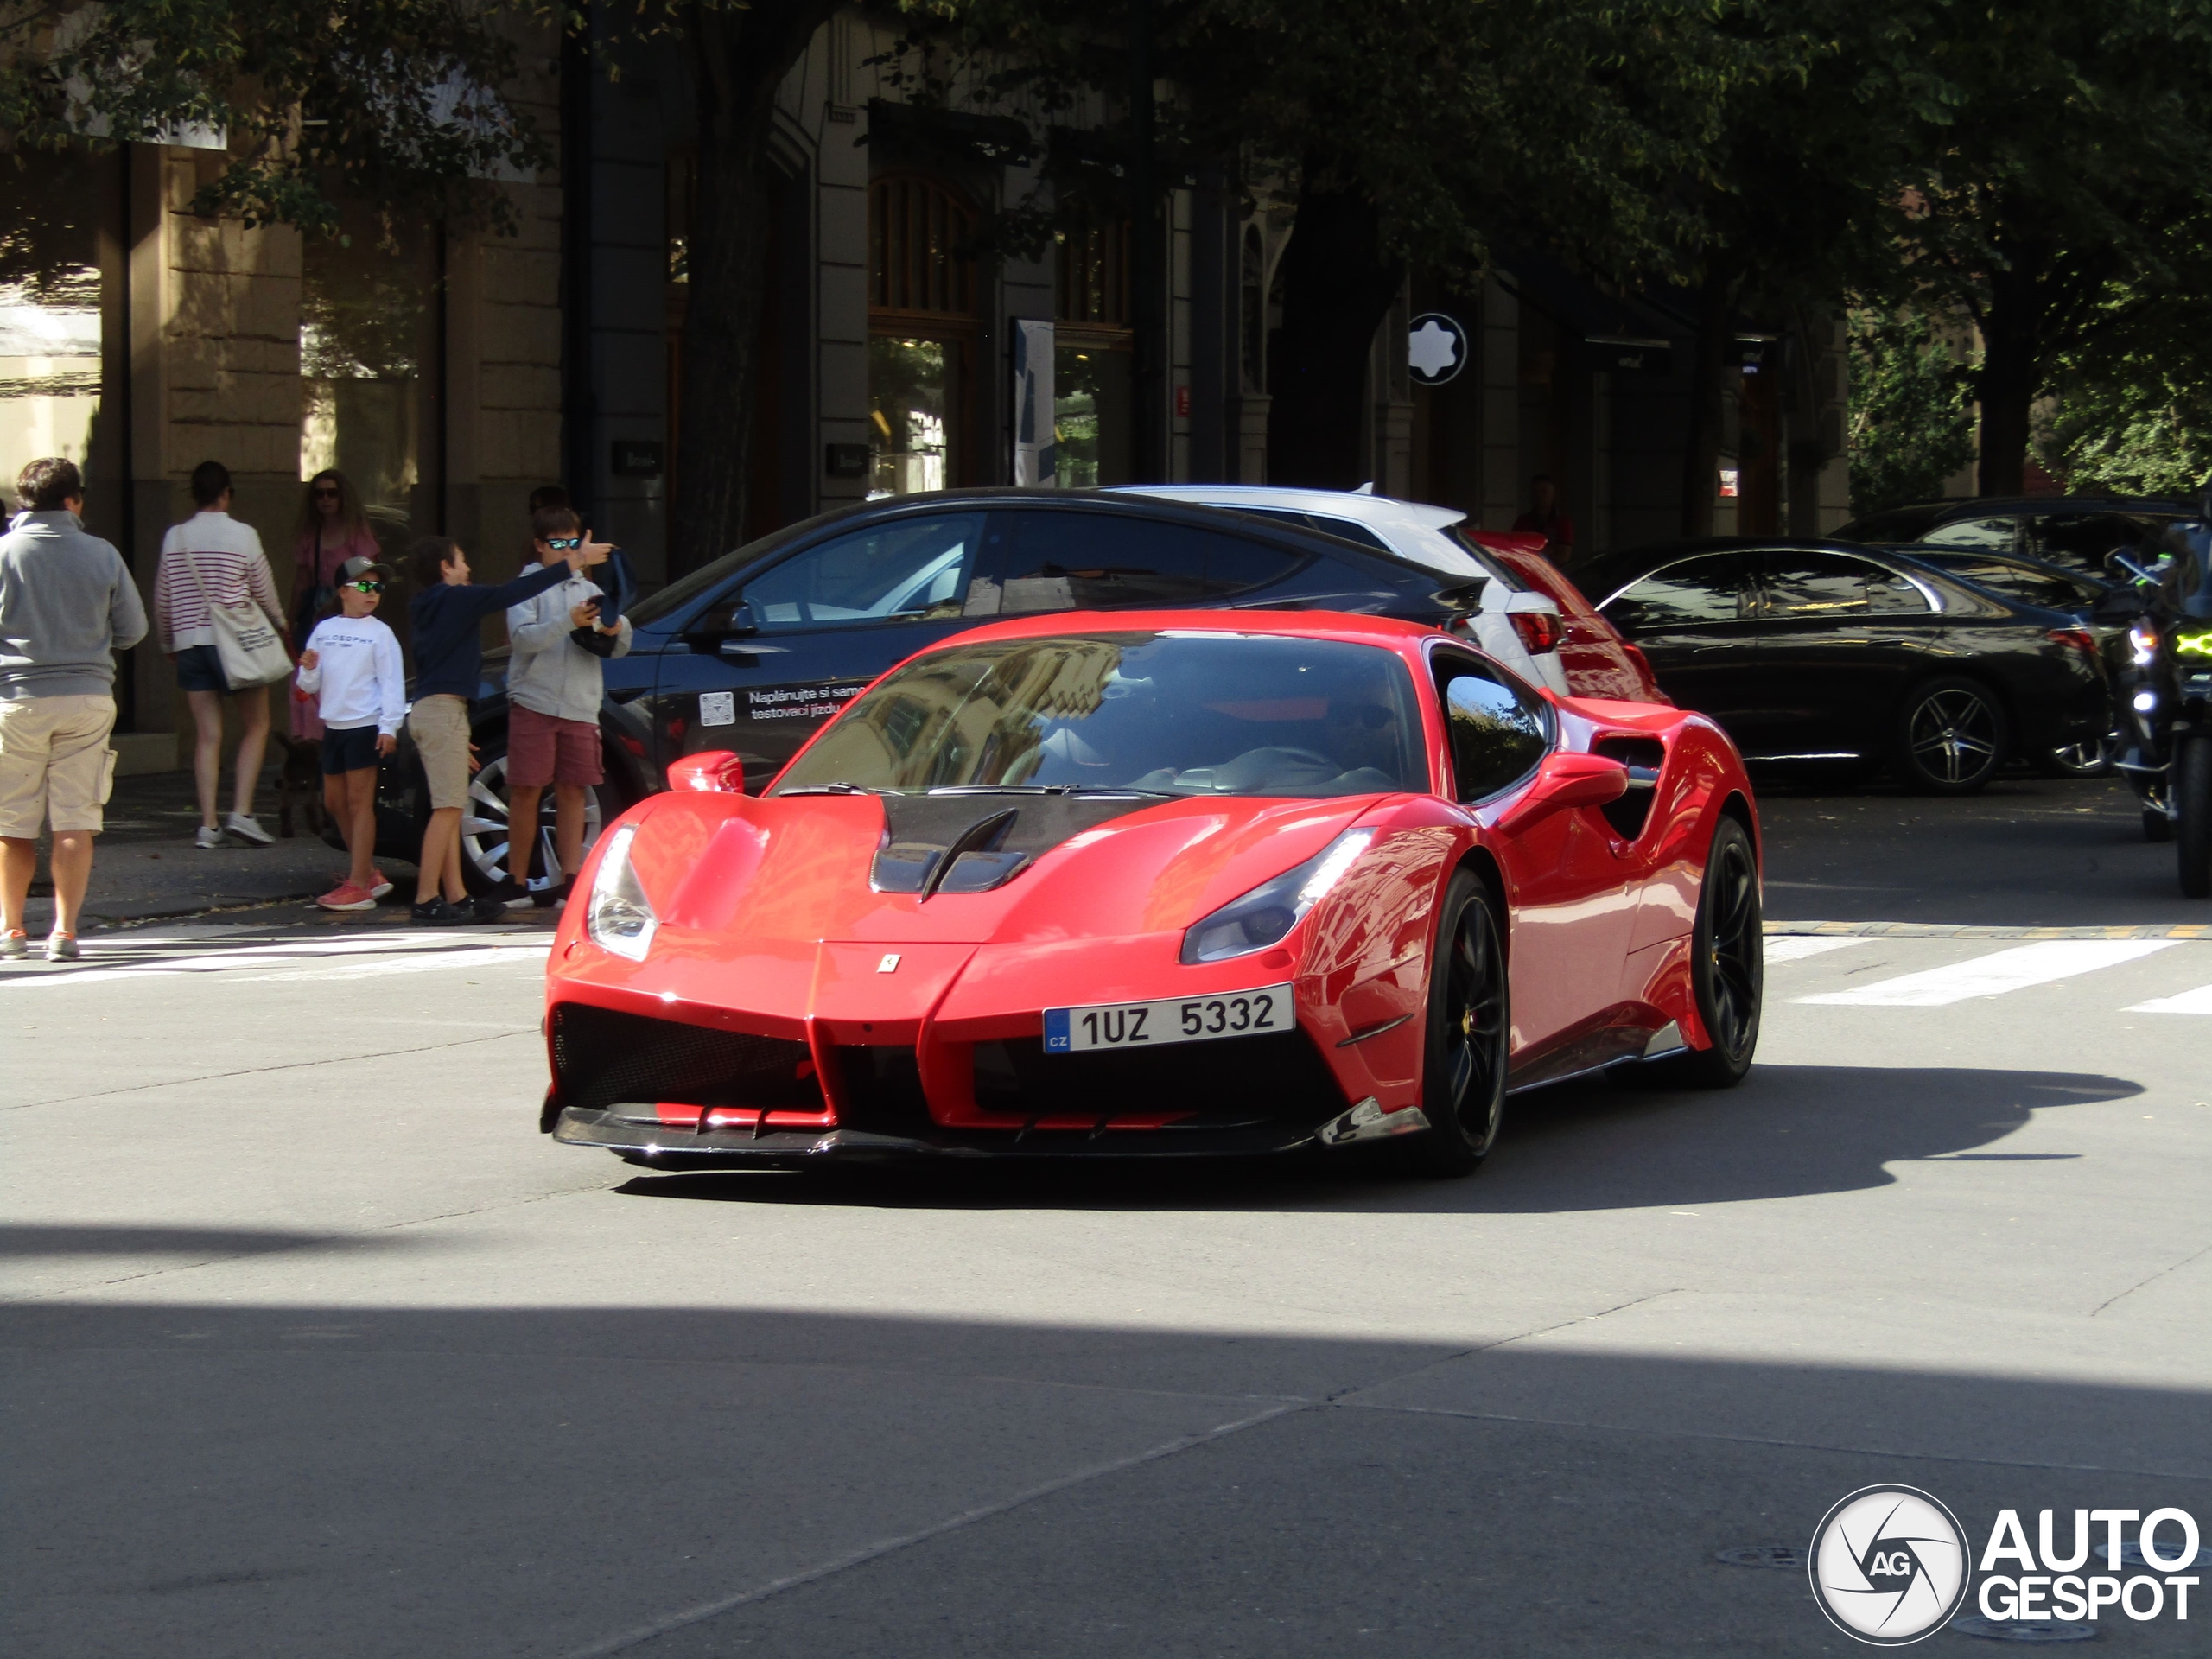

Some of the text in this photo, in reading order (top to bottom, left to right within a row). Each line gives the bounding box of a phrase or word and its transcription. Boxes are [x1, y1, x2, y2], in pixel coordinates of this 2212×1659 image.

[748, 688, 817, 705] Naplánujte
[818, 686, 830, 698] si
[1083, 995, 1274, 1045] 1UZ 5332
[1049, 1035, 1068, 1047] CZ
